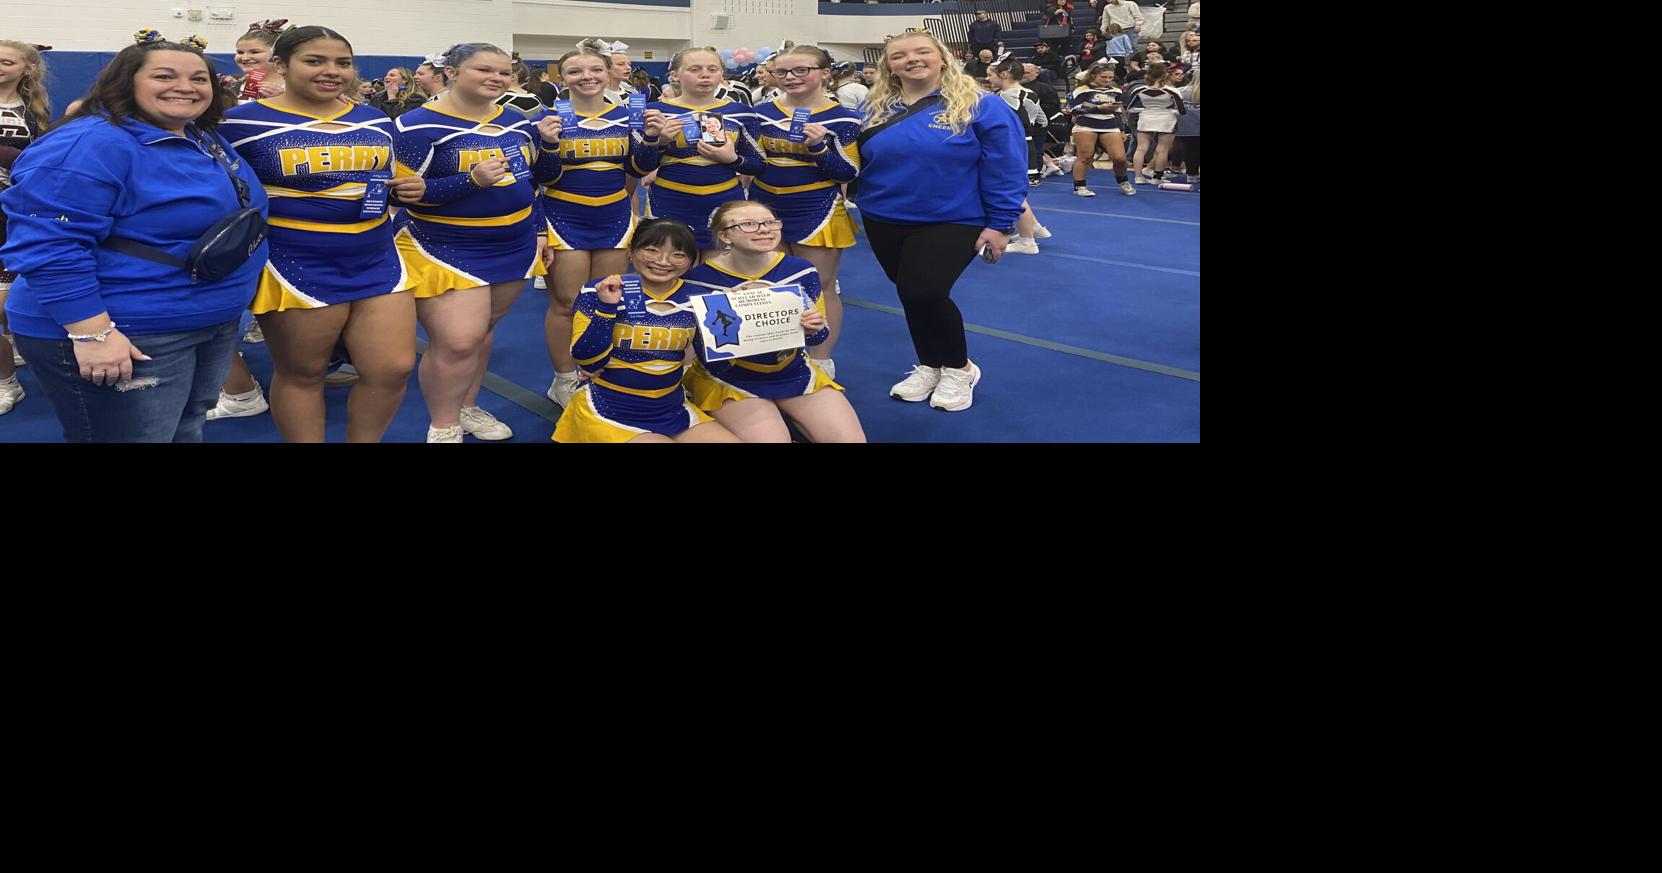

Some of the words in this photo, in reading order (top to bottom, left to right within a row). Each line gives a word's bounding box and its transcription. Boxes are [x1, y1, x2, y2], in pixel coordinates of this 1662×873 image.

[560, 137, 629, 158] PERRY
[279, 145, 390, 177] PERRY
[744, 308, 799, 321] DIRECTORS
[755, 316, 791, 328] CHOICE
